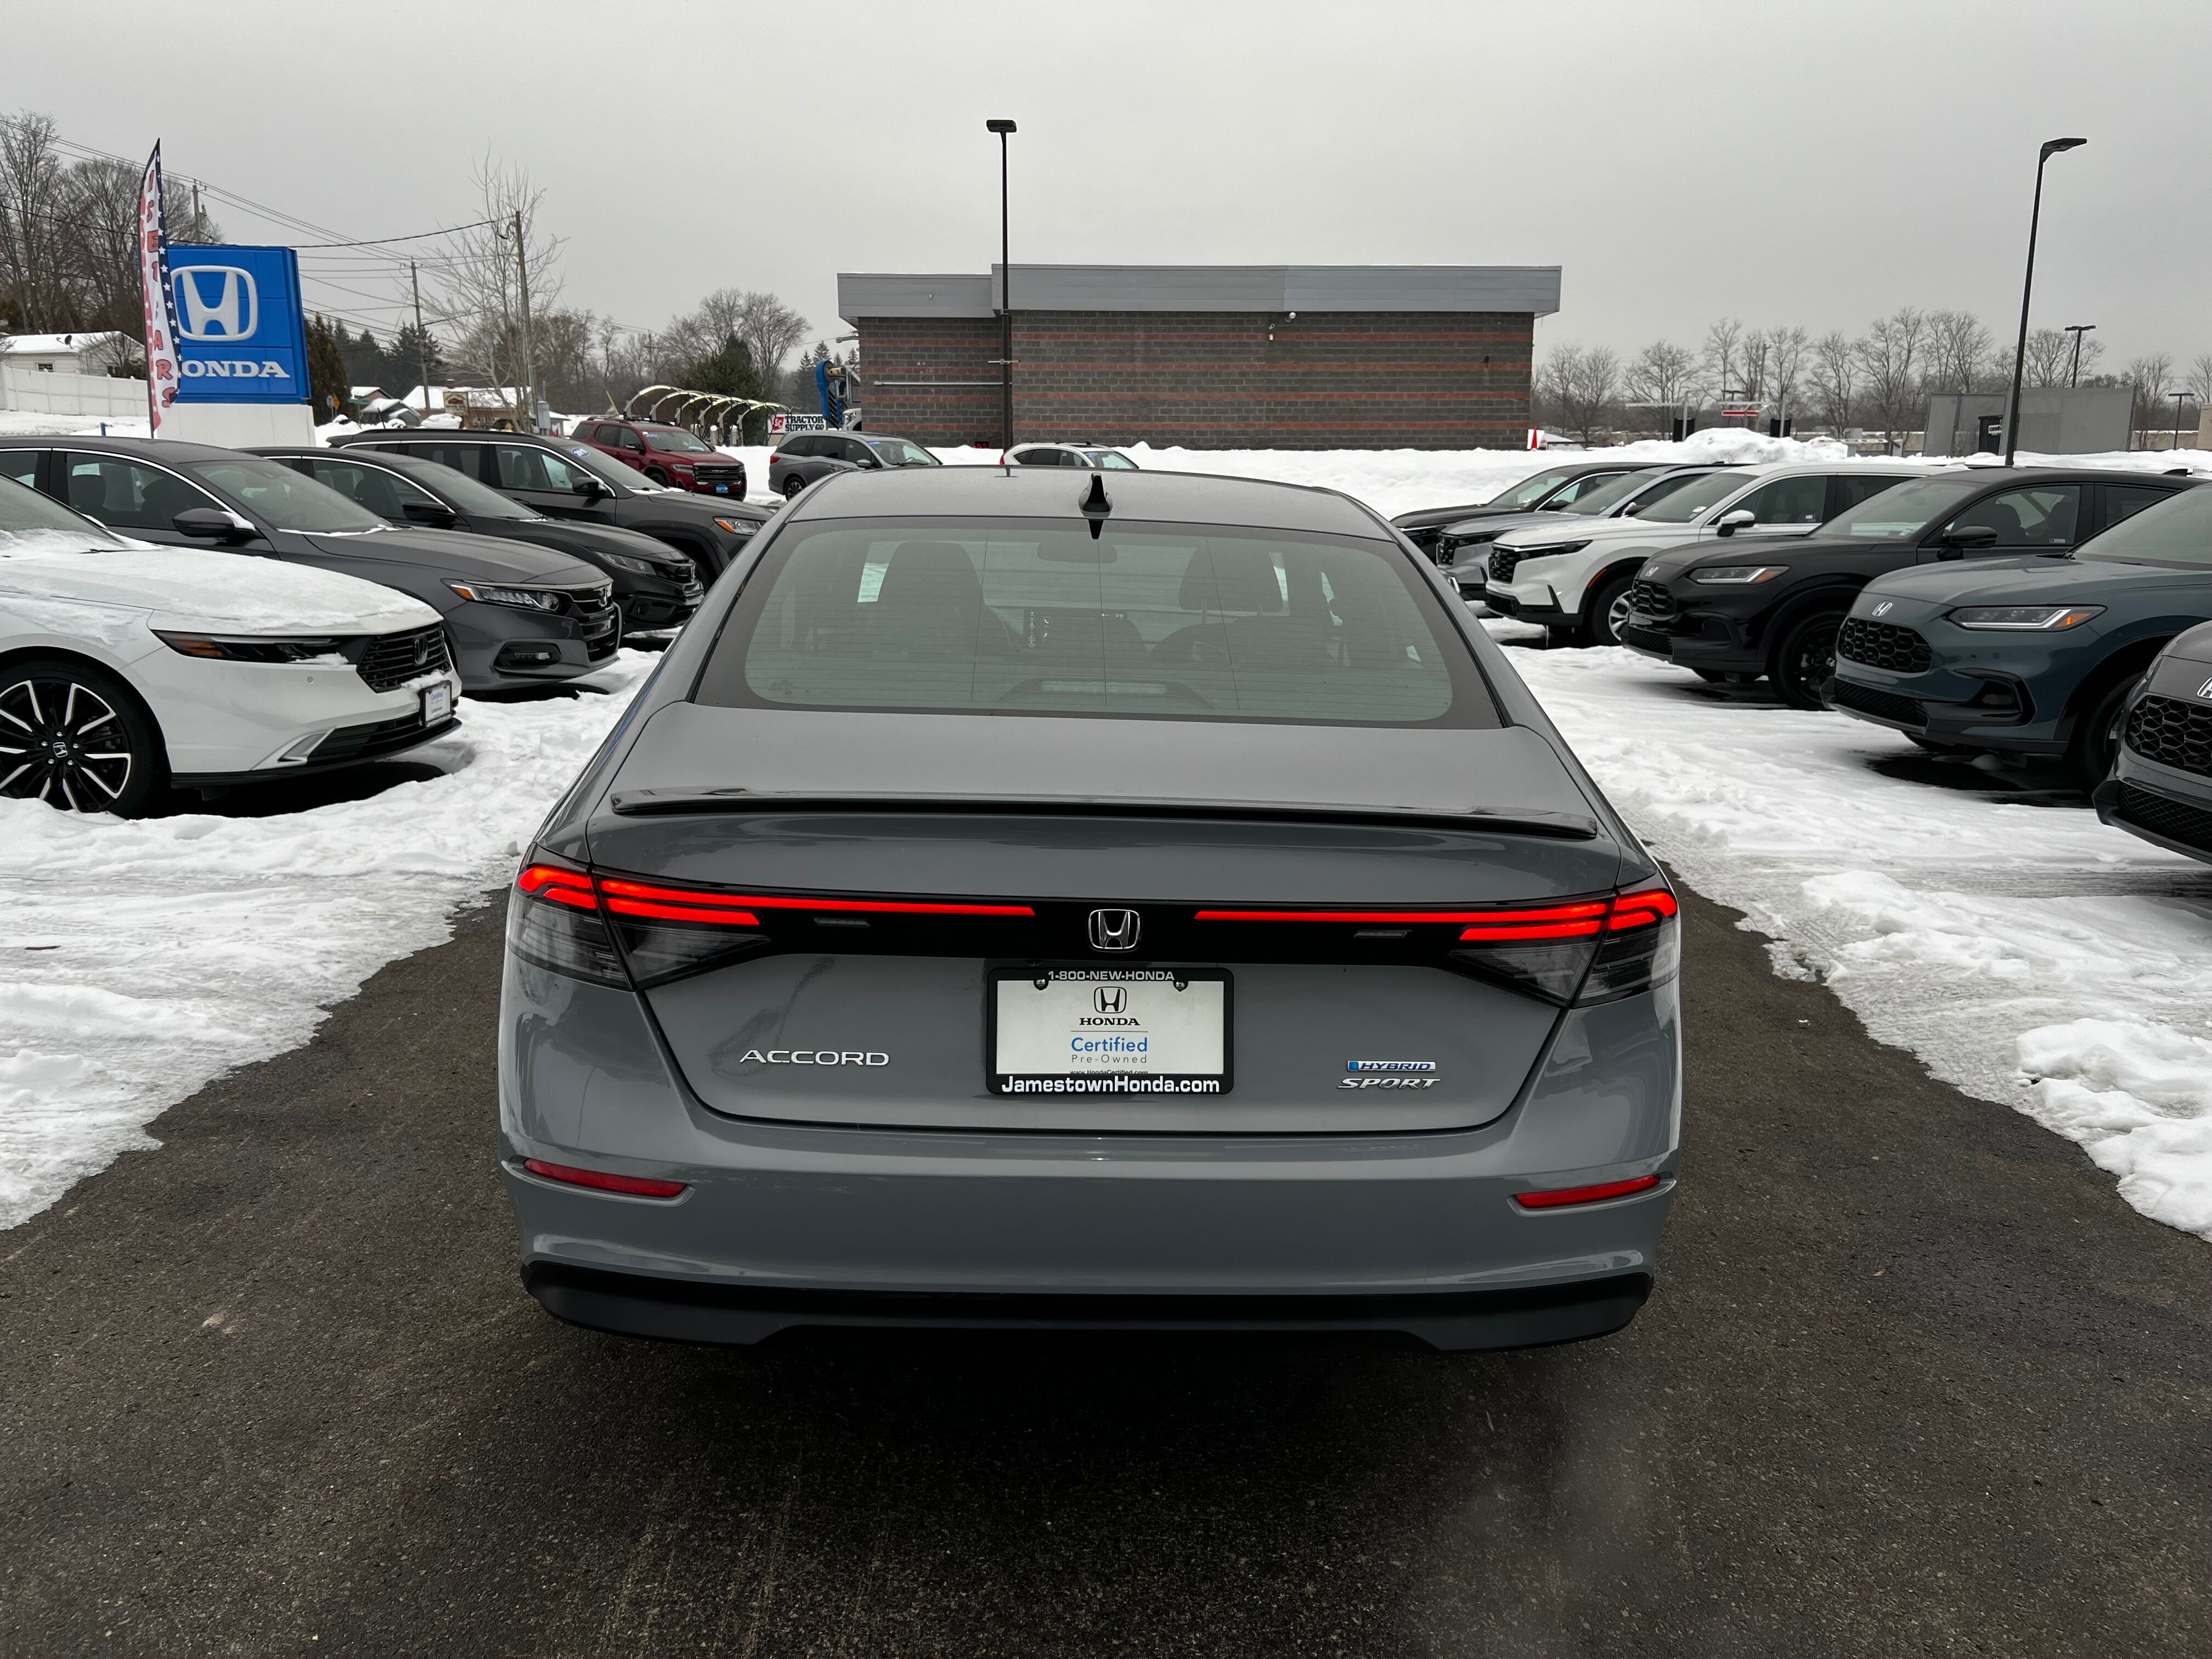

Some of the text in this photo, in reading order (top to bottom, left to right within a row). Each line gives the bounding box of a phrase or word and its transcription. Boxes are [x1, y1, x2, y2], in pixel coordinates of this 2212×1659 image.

[182, 360, 290, 378] ONDA
[1048, 971, 1175, 981] 1-800-NEW-HONDA
[1079, 1018, 1141, 1026] HONDA
[1071, 1037, 1148, 1052] Certified
[739, 1049, 889, 1066] ACCORD
[1071, 1054, 1147, 1064] Pre-Owned
[1001, 1075, 1220, 1092] JamestownHonda.com
[1338, 1078, 1441, 1089] SPORT
